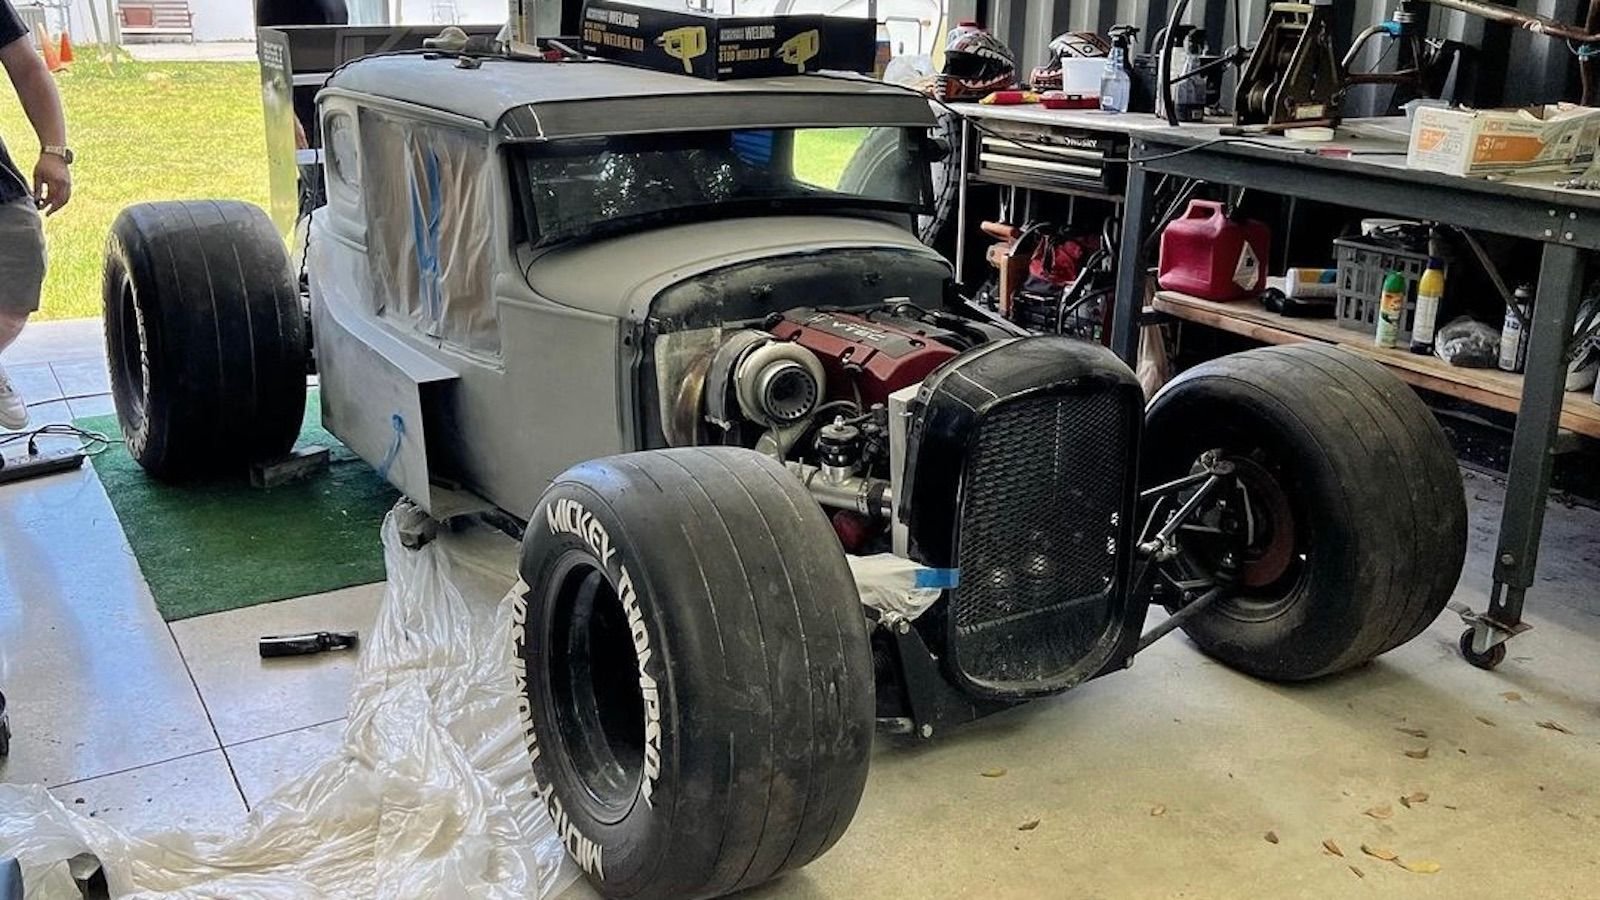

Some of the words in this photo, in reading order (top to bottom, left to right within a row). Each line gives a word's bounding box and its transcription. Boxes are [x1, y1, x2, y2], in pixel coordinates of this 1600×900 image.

[745, 25, 775, 41] WELDING
[546, 498, 616, 568] MICKEY
[617, 564, 662, 810] THOMPSON
